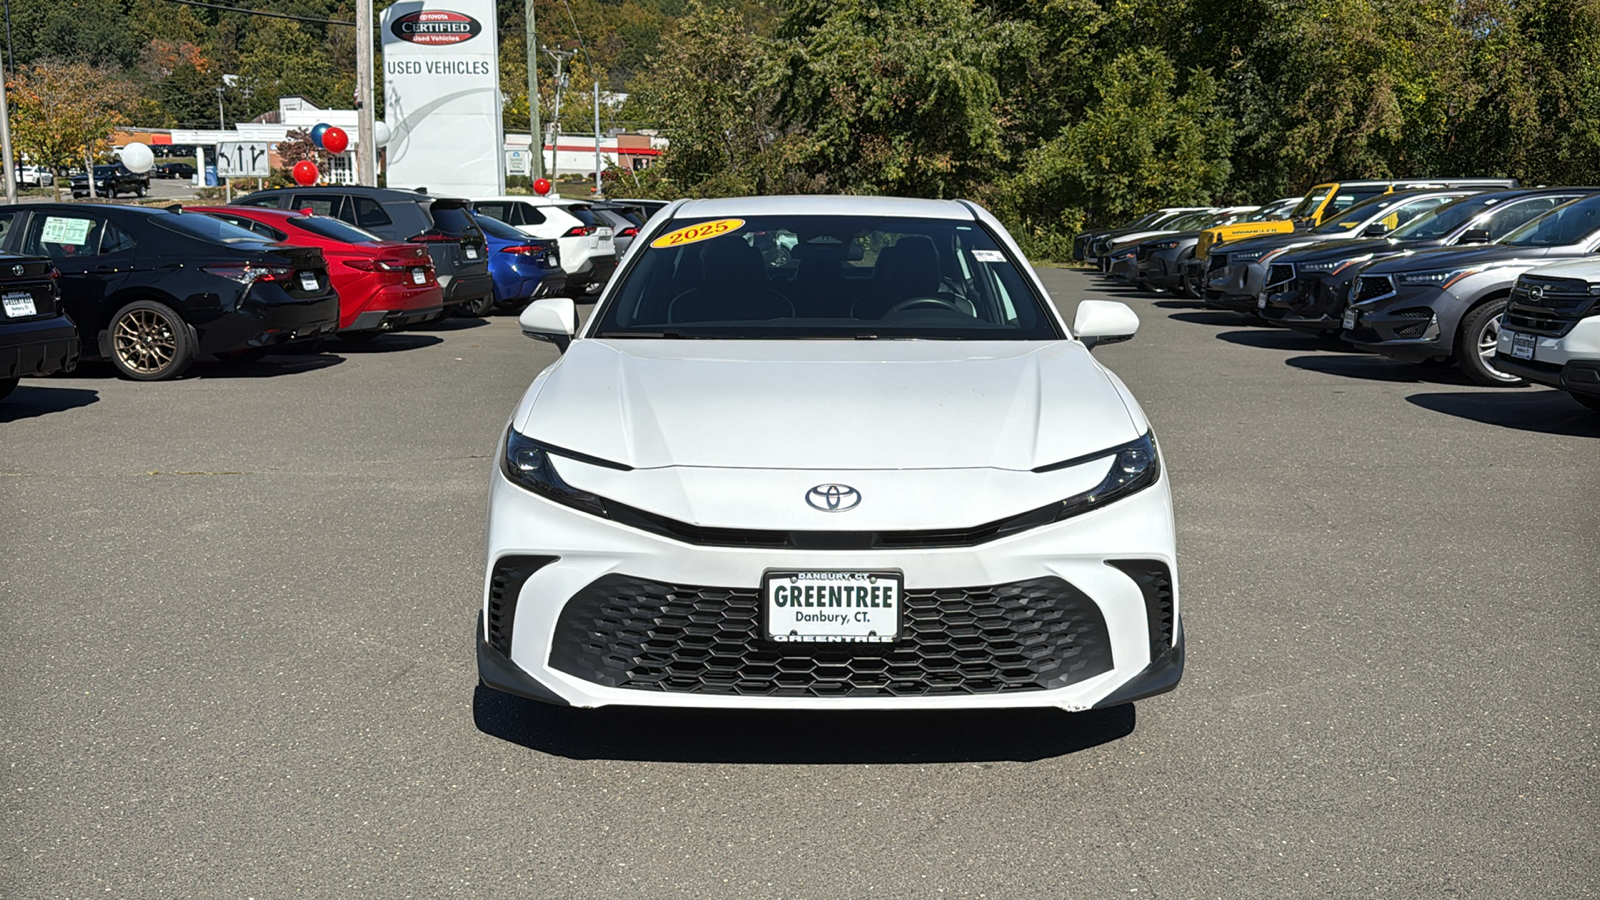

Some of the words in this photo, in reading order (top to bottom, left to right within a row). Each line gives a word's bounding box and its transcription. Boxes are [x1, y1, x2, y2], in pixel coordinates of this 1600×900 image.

[402, 22, 470, 33] CERTIFIED
[388, 61, 422, 75] USED
[426, 61, 489, 75] VEHICLES
[669, 221, 729, 245] 2025
[798, 573, 852, 582] DANBURY,
[854, 573, 870, 581] CT
[774, 585, 893, 608] GREENTREE
[795, 610, 850, 625] Danbury,
[854, 611, 870, 623] CT.
[774, 635, 893, 643] GREENTREE
